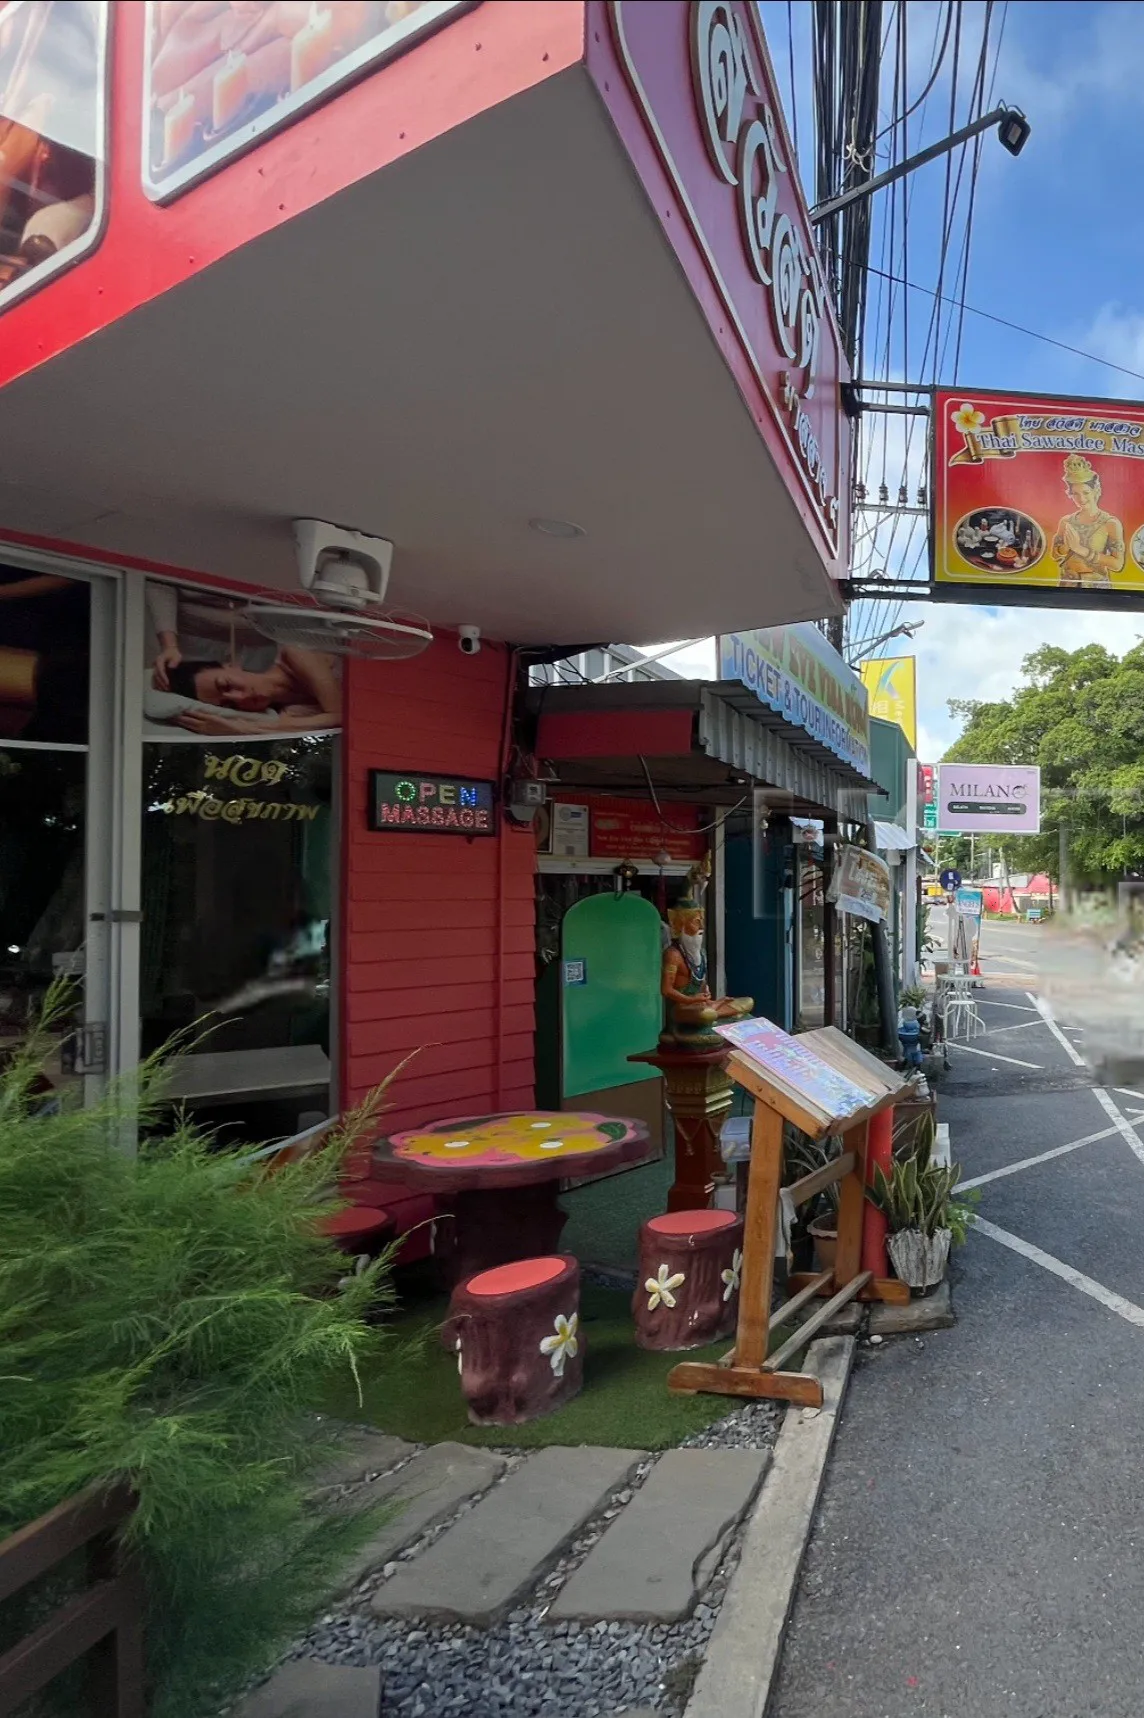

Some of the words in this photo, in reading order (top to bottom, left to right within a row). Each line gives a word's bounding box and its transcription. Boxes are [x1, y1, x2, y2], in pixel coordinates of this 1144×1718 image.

[976, 432, 1016, 450] Thai
[1022, 432, 1105, 451] Sawasdee
[731, 635, 780, 702] TICKET
[784, 680, 792, 711] &
[794, 687, 820, 731] TOUR
[204, 754, 288, 787] นวด
[395, 780, 477, 806] OPEN
[380, 802, 489, 829] MASSAGE
